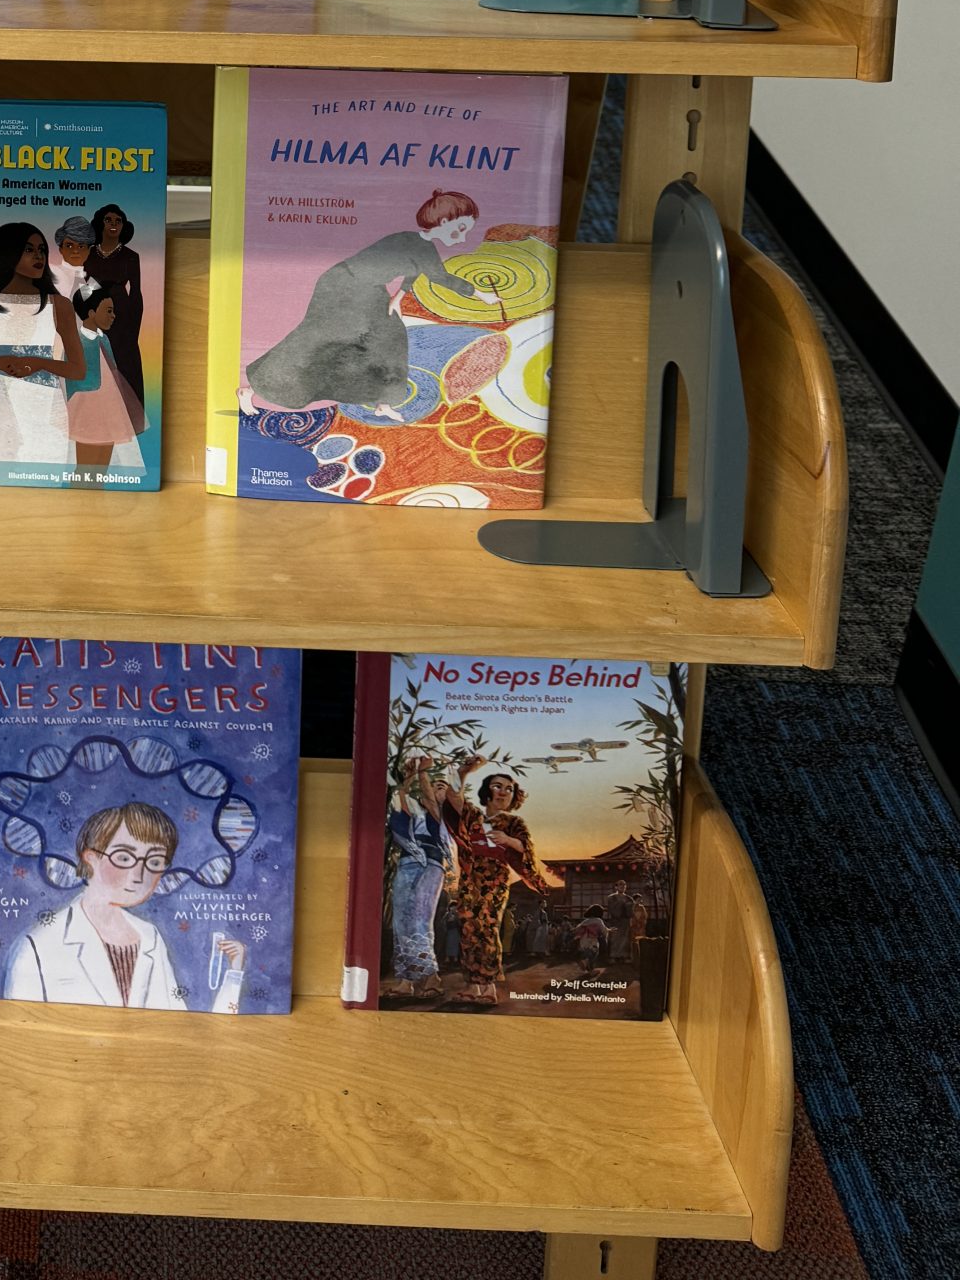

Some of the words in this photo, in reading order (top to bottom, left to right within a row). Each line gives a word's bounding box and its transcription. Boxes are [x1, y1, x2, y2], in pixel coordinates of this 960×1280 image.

[312, 101, 339, 116] THE
[348, 99, 376, 112] ART
[383, 101, 416, 113] AND
[424, 104, 456, 119] LIFE
[463, 109, 482, 121] OF
[54, 123, 104, 132] Smithsonian
[80, 147, 154, 172] FIRST.
[270, 139, 368, 165] HILMA
[379, 143, 422, 167] AF
[428, 144, 520, 171] KLINT
[2, 178, 55, 190] American
[59, 180, 102, 191] Women
[30, 195, 49, 206] the
[52, 196, 86, 207] World
[269, 196, 294, 206] YLVA
[280, 213, 311, 223] KARIN
[316, 215, 357, 225] EKLUND
[62, 472, 81, 482] Erin
[96, 473, 141, 484] Robinson
[251, 468, 288, 478] Thames
[423, 661, 460, 684] No
[467, 663, 540, 691] Steps
[548, 666, 642, 688] Behind
[446, 693, 472, 701] Beate
[474, 693, 500, 702] Sirota
[502, 694, 542, 703] Gordon's
[460, 704, 499, 713] Women's
[501, 705, 528, 714] Rights
[540, 706, 565, 714] Japan
[134, 719, 170, 728] BATTLE
[175, 720, 219, 730] AGAINST
[226, 722, 273, 732] COVID-19
[192, 903, 245, 911] VIVIEN
[174, 911, 272, 921] MILDENBERGER
[564, 980, 580, 989] Jeff
[582, 981, 626, 990] Gottesfeld
[565, 993, 590, 1002] Shiella
[593, 994, 626, 1003] Witanto
